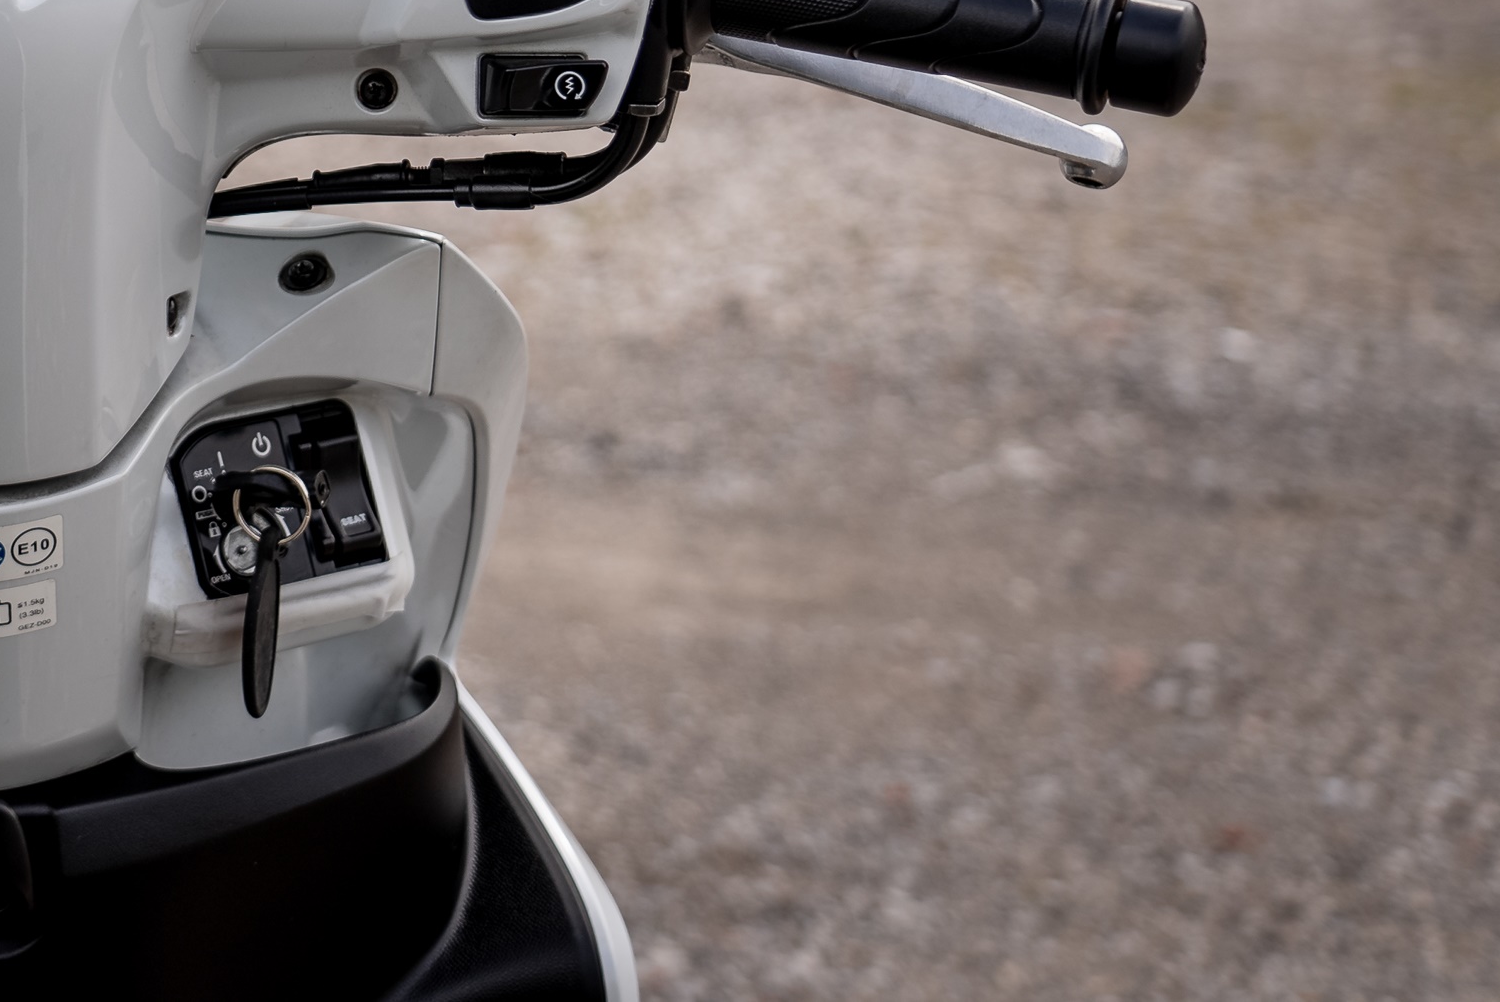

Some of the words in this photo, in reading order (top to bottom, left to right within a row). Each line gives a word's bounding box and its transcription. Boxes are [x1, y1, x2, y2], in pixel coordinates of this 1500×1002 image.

[193, 468, 213, 478] SEAT
[341, 513, 366, 526] SEAT
[18, 538, 49, 555] E10
[211, 573, 231, 583] OPEN
